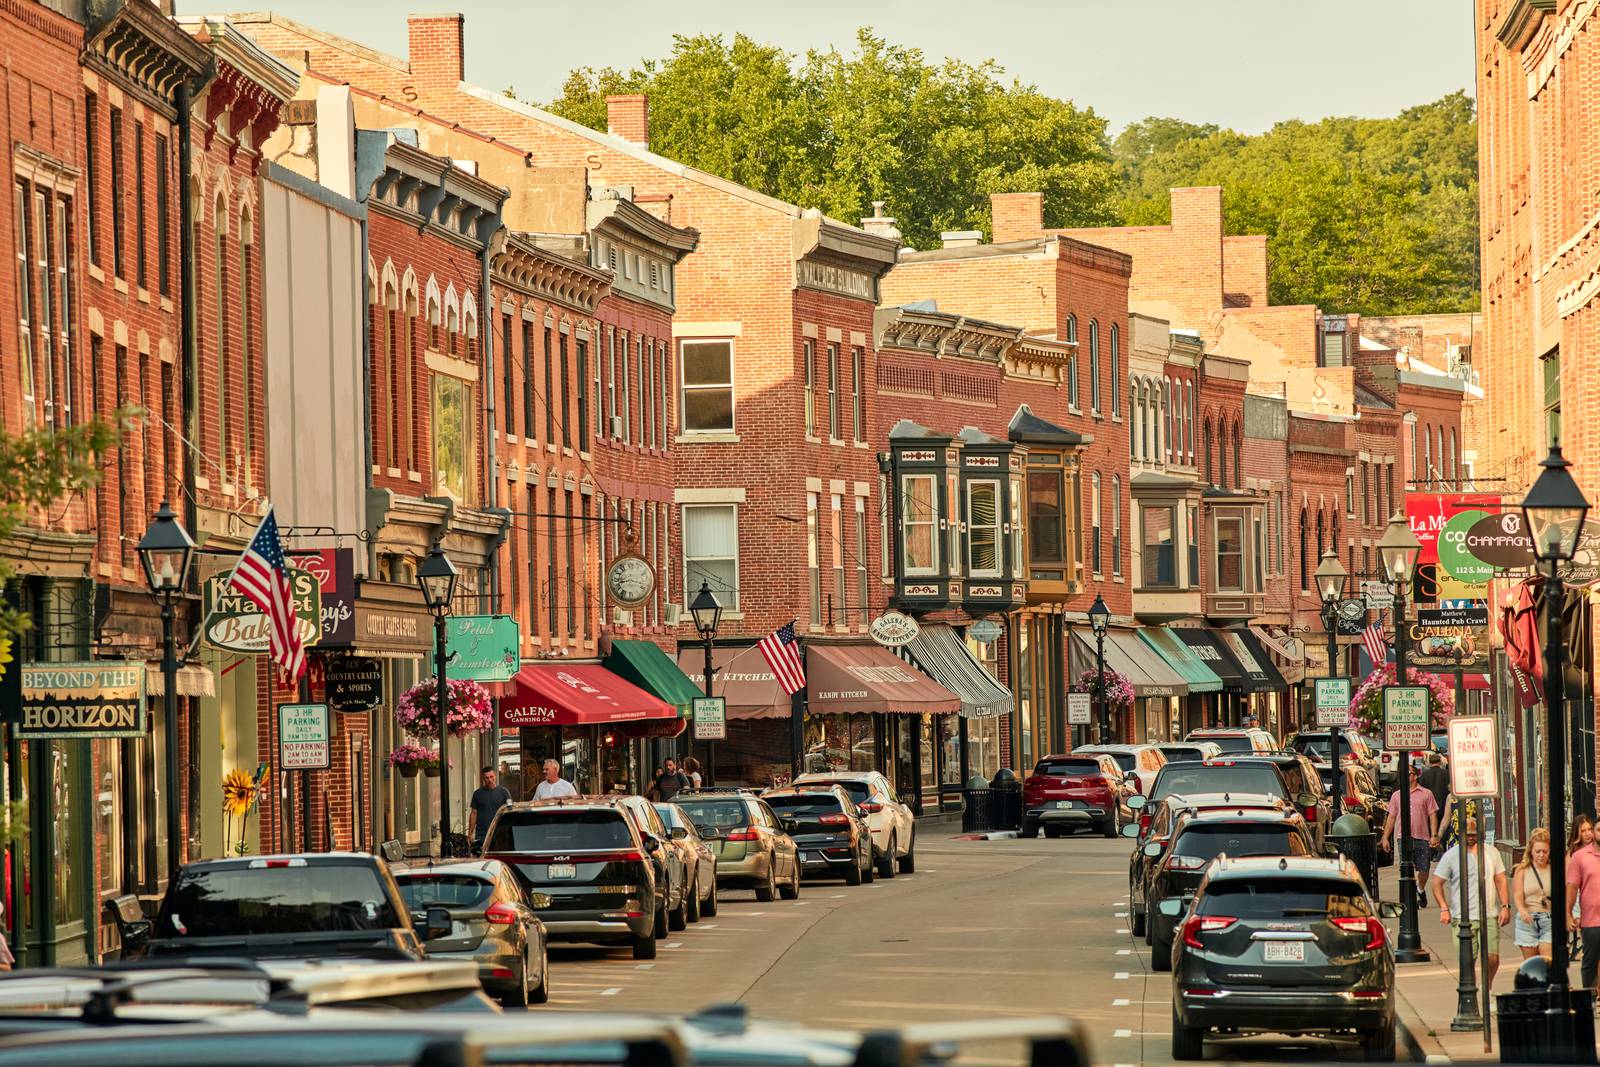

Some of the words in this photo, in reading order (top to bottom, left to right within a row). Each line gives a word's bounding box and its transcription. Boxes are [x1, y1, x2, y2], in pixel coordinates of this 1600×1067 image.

[837, 268, 869, 297] BUILDING
[1410, 515, 1426, 531] La
[1456, 566, 1467, 574] 112
[1476, 566, 1494, 574] Main
[220, 596, 313, 614] Maet
[1421, 618, 1450, 626] Haunted
[1451, 617, 1465, 625] Pub
[1466, 617, 1487, 625] Crawl
[214, 613, 313, 643] Baky
[1409, 624, 1475, 641] GALENA
[22, 671, 96, 688] BEYOND
[100, 670, 138, 687] THE
[326, 672, 356, 681] COUNTRY
[356, 671, 381, 680] CRAFTS
[688, 674, 719, 682] ANY
[722, 673, 776, 681] KITCHEN
[336, 684, 345, 693] &
[348, 683, 372, 692] SPORTS
[818, 691, 839, 699] KANDY
[840, 690, 868, 698] KITCHEN
[1391, 699, 1422, 708] PARKING
[22, 705, 137, 728] HORIZON
[504, 706, 556, 719] GALENA
[287, 717, 320, 726] PARKING
[1465, 725, 1479, 738] NO
[284, 743, 294, 751] NO
[295, 743, 325, 751] PARKING
[1457, 740, 1489, 753] PARKING
[1456, 759, 1478, 768] LOADING
